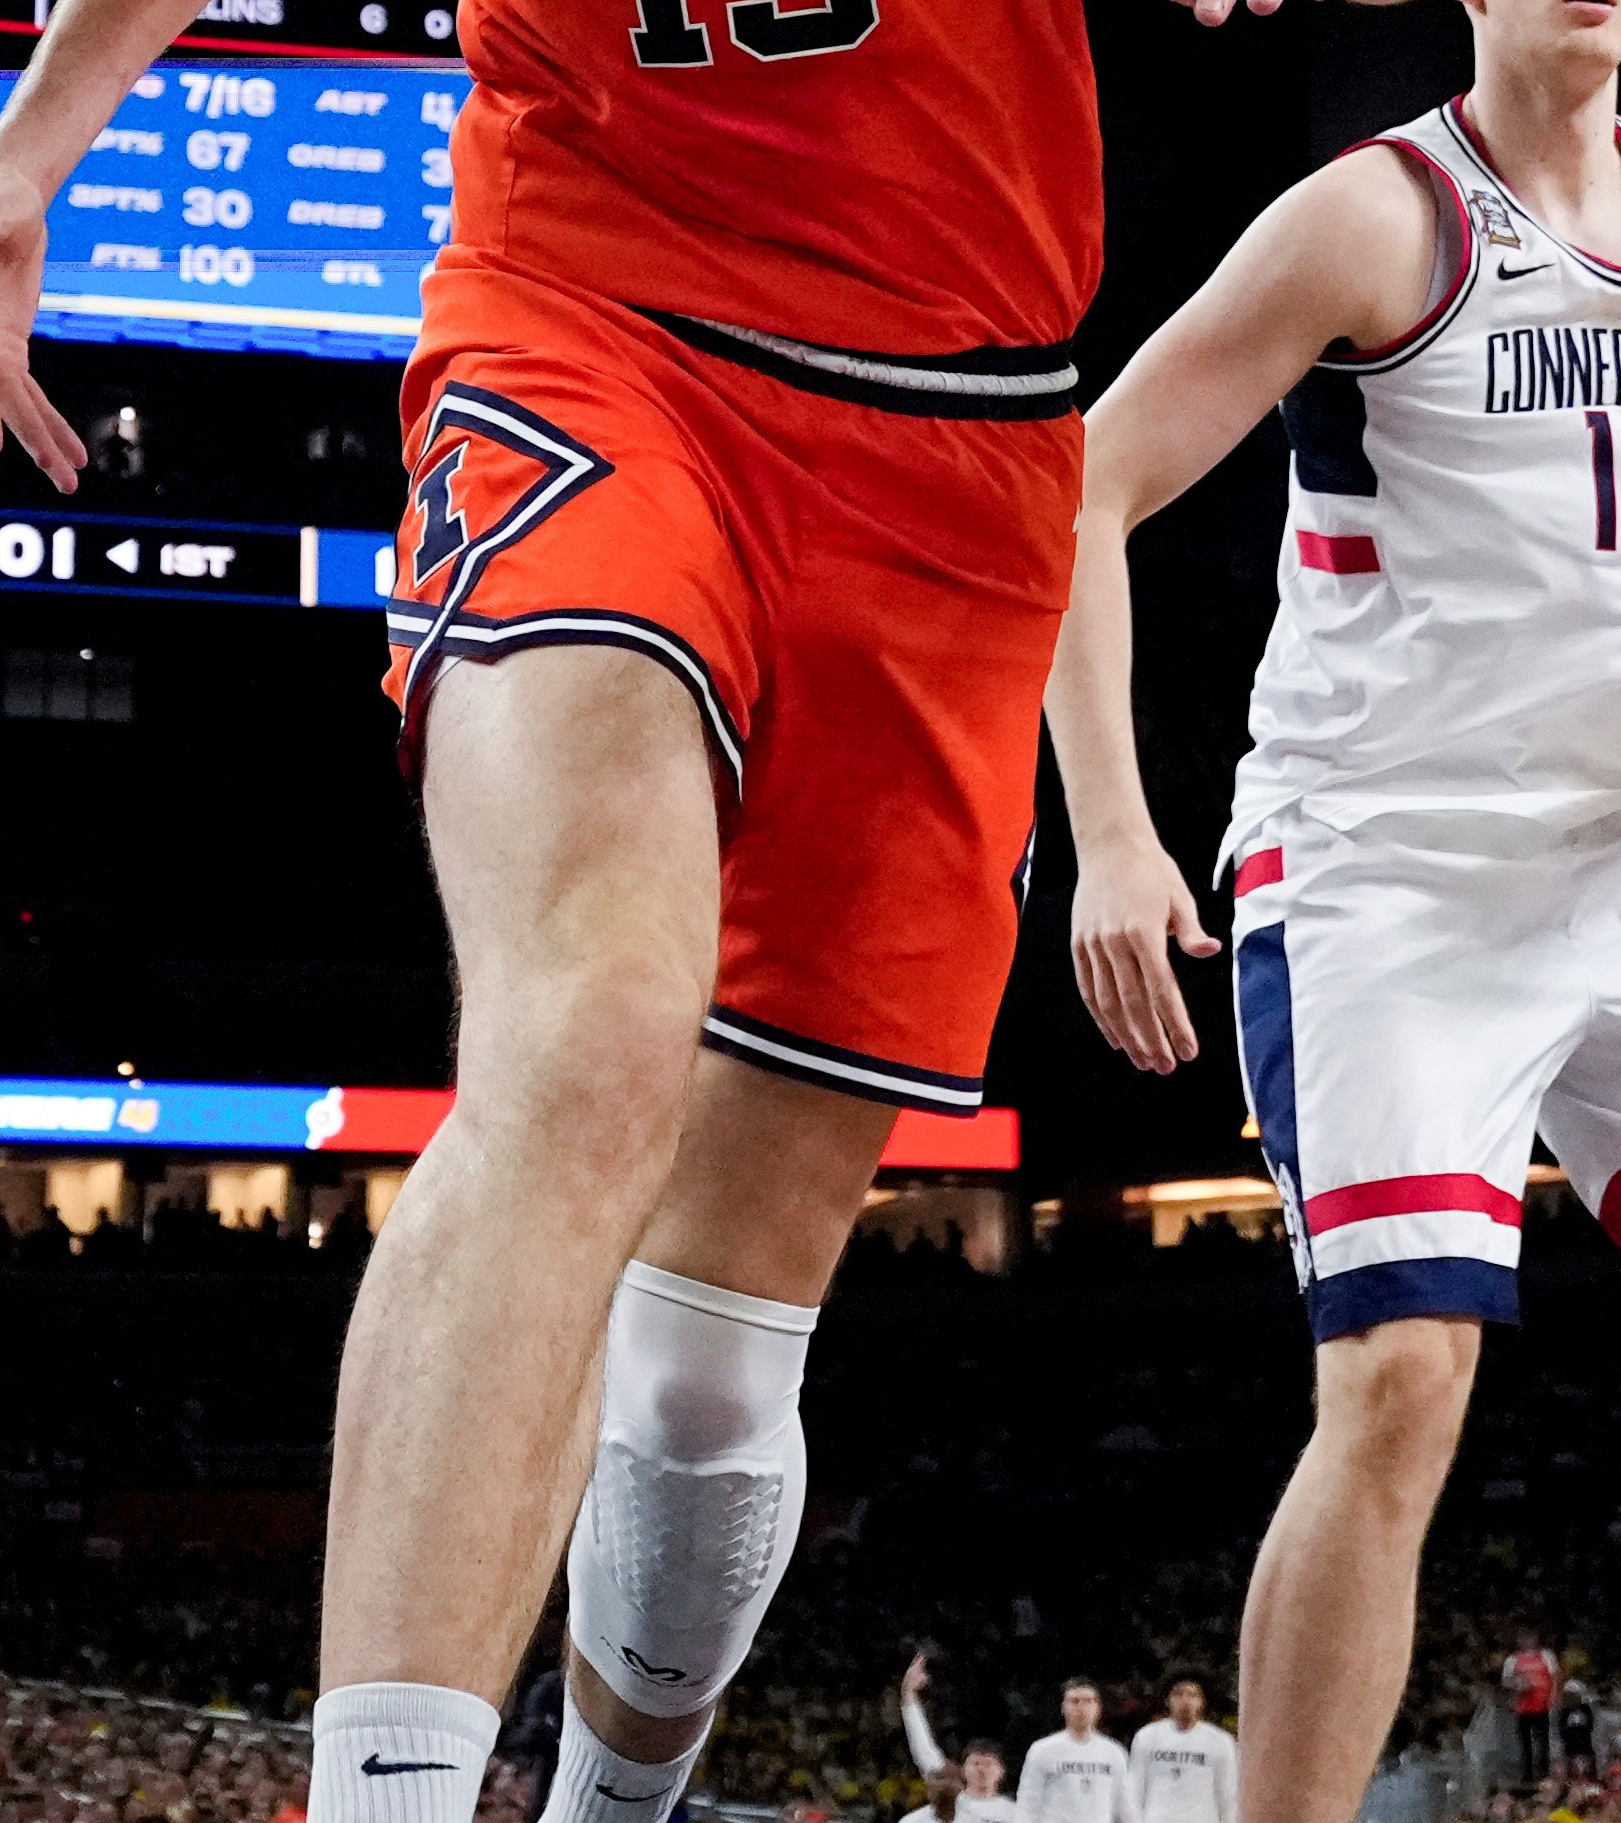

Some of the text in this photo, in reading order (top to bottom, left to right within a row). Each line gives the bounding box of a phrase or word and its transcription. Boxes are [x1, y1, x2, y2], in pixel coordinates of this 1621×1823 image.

[424, 9, 454, 40] 0
[313, 89, 389, 116] AST
[185, 129, 251, 172] 67
[181, 186, 254, 229] 30
[179, 243, 255, 288] 100
